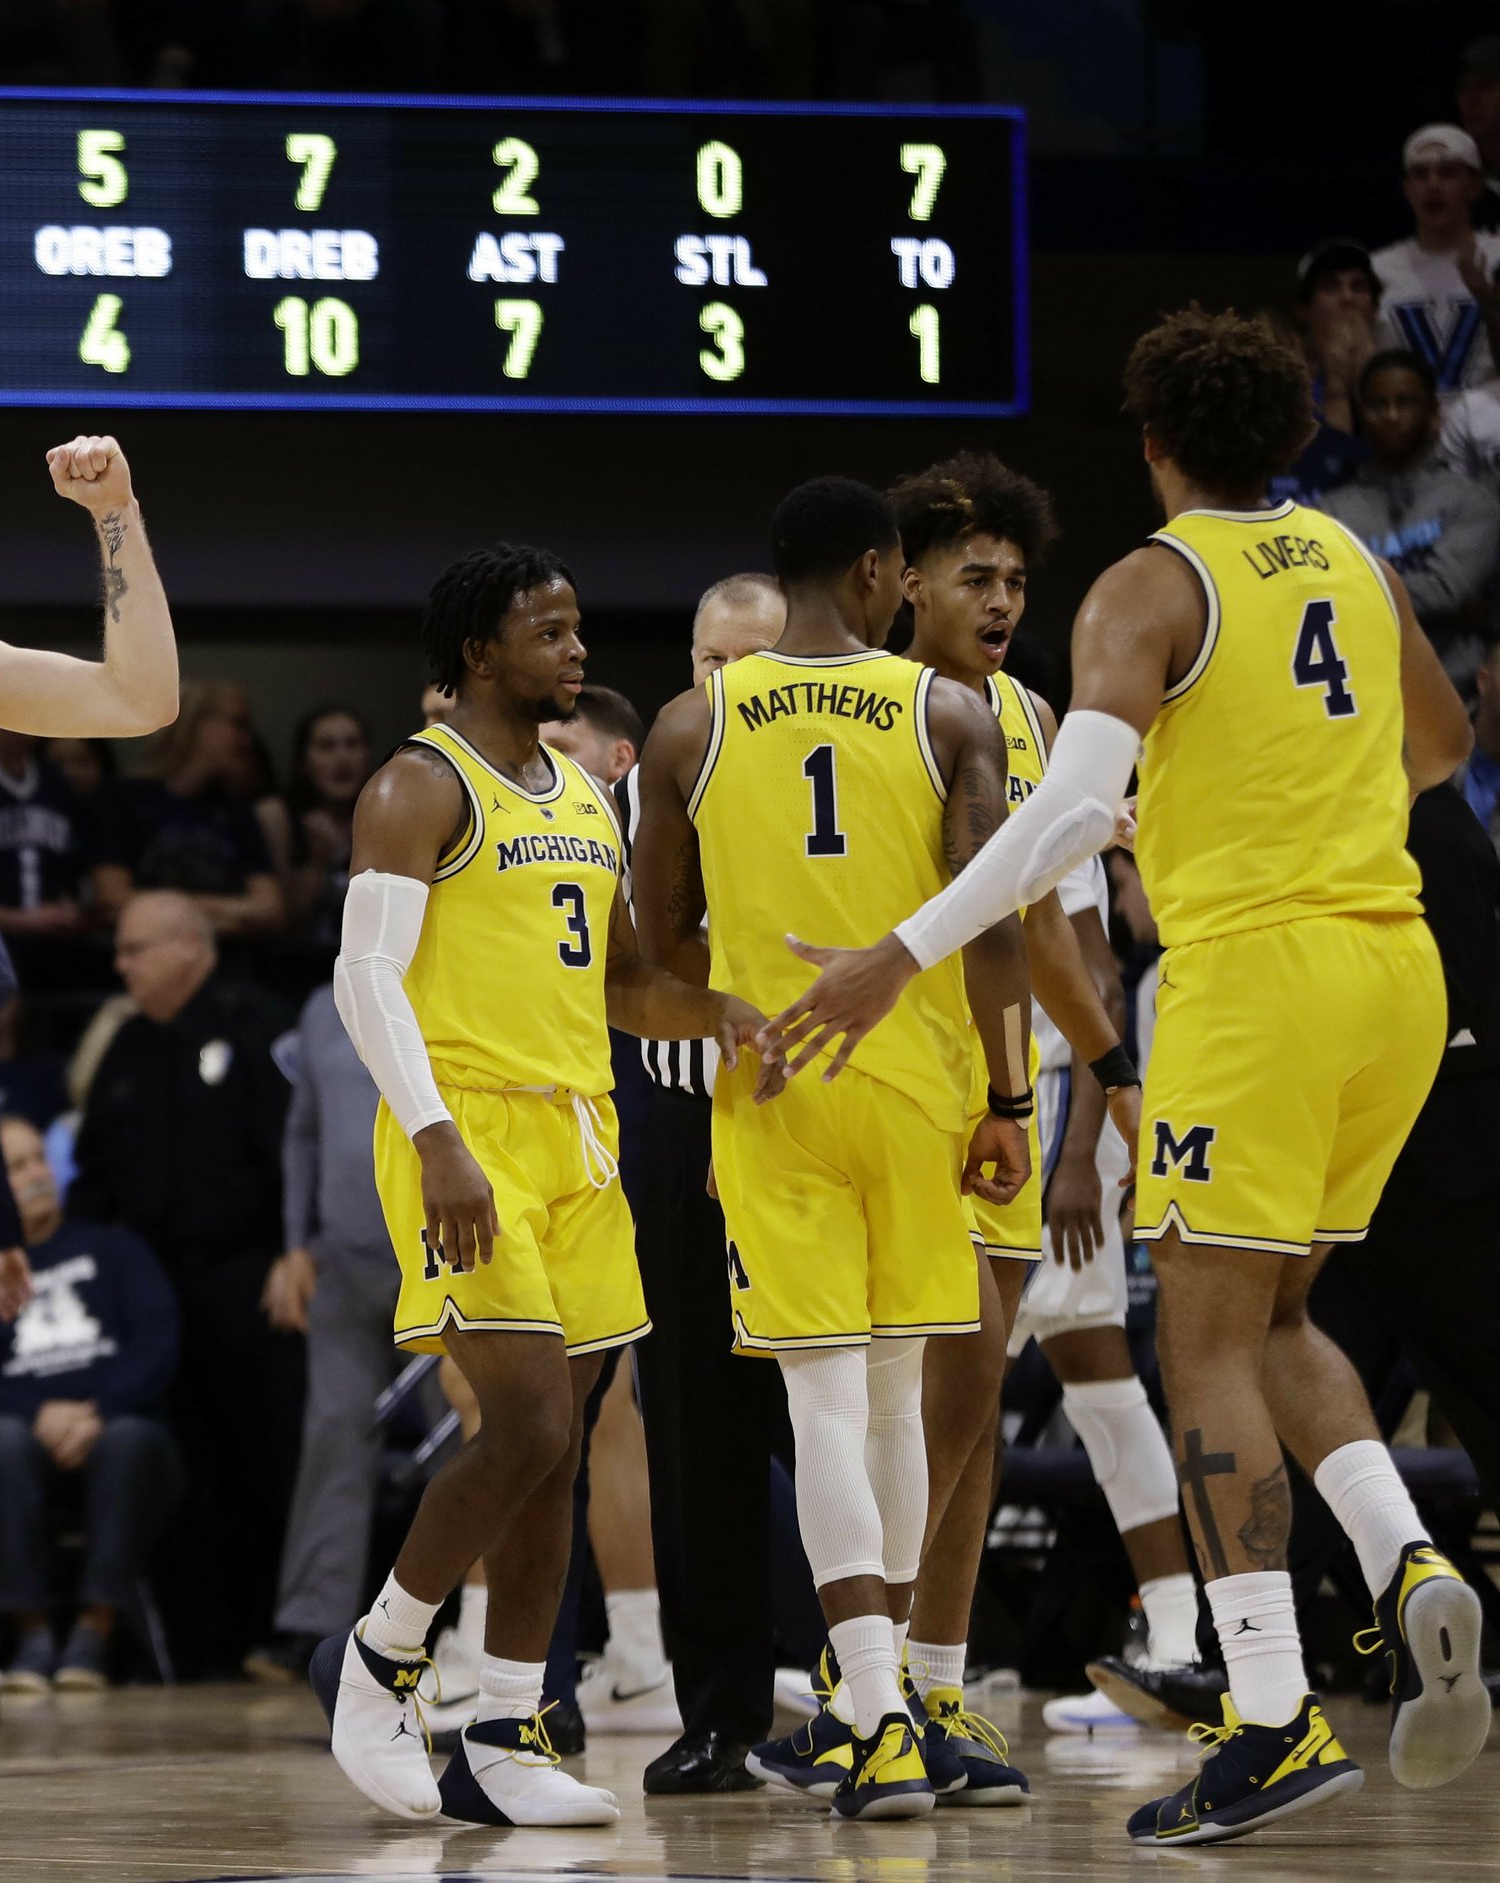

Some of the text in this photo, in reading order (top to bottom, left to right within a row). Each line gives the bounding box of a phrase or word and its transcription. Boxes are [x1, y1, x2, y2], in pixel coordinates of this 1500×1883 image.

[76, 128, 129, 209] 5
[284, 132, 337, 213] 7
[491, 136, 541, 216] 2
[695, 140, 744, 219] 0
[899, 142, 948, 222] 7
[33, 224, 174, 279] OREB
[242, 227, 380, 282] DREB
[467, 231, 566, 285] AST
[673, 233, 769, 288] STL
[889, 237, 956, 290] TO
[78, 292, 132, 374] 4
[272, 295, 360, 378] 10
[493, 298, 544, 380] 7
[698, 301, 746, 382] 3
[908, 303, 941, 385] 1
[1241, 535, 1330, 580] LIVERS
[1291, 598, 1359, 720] 4
[737, 682, 903, 732] MATTHEWS
[802, 743, 847, 858] 1
[496, 834, 619, 880] MICHIGAN
[551, 882, 592, 969] 3
[1150, 1119, 1218, 1184] M
[393, 1668, 421, 1687] M
[938, 1700, 960, 1718] M
[519, 1725, 538, 1744] M
